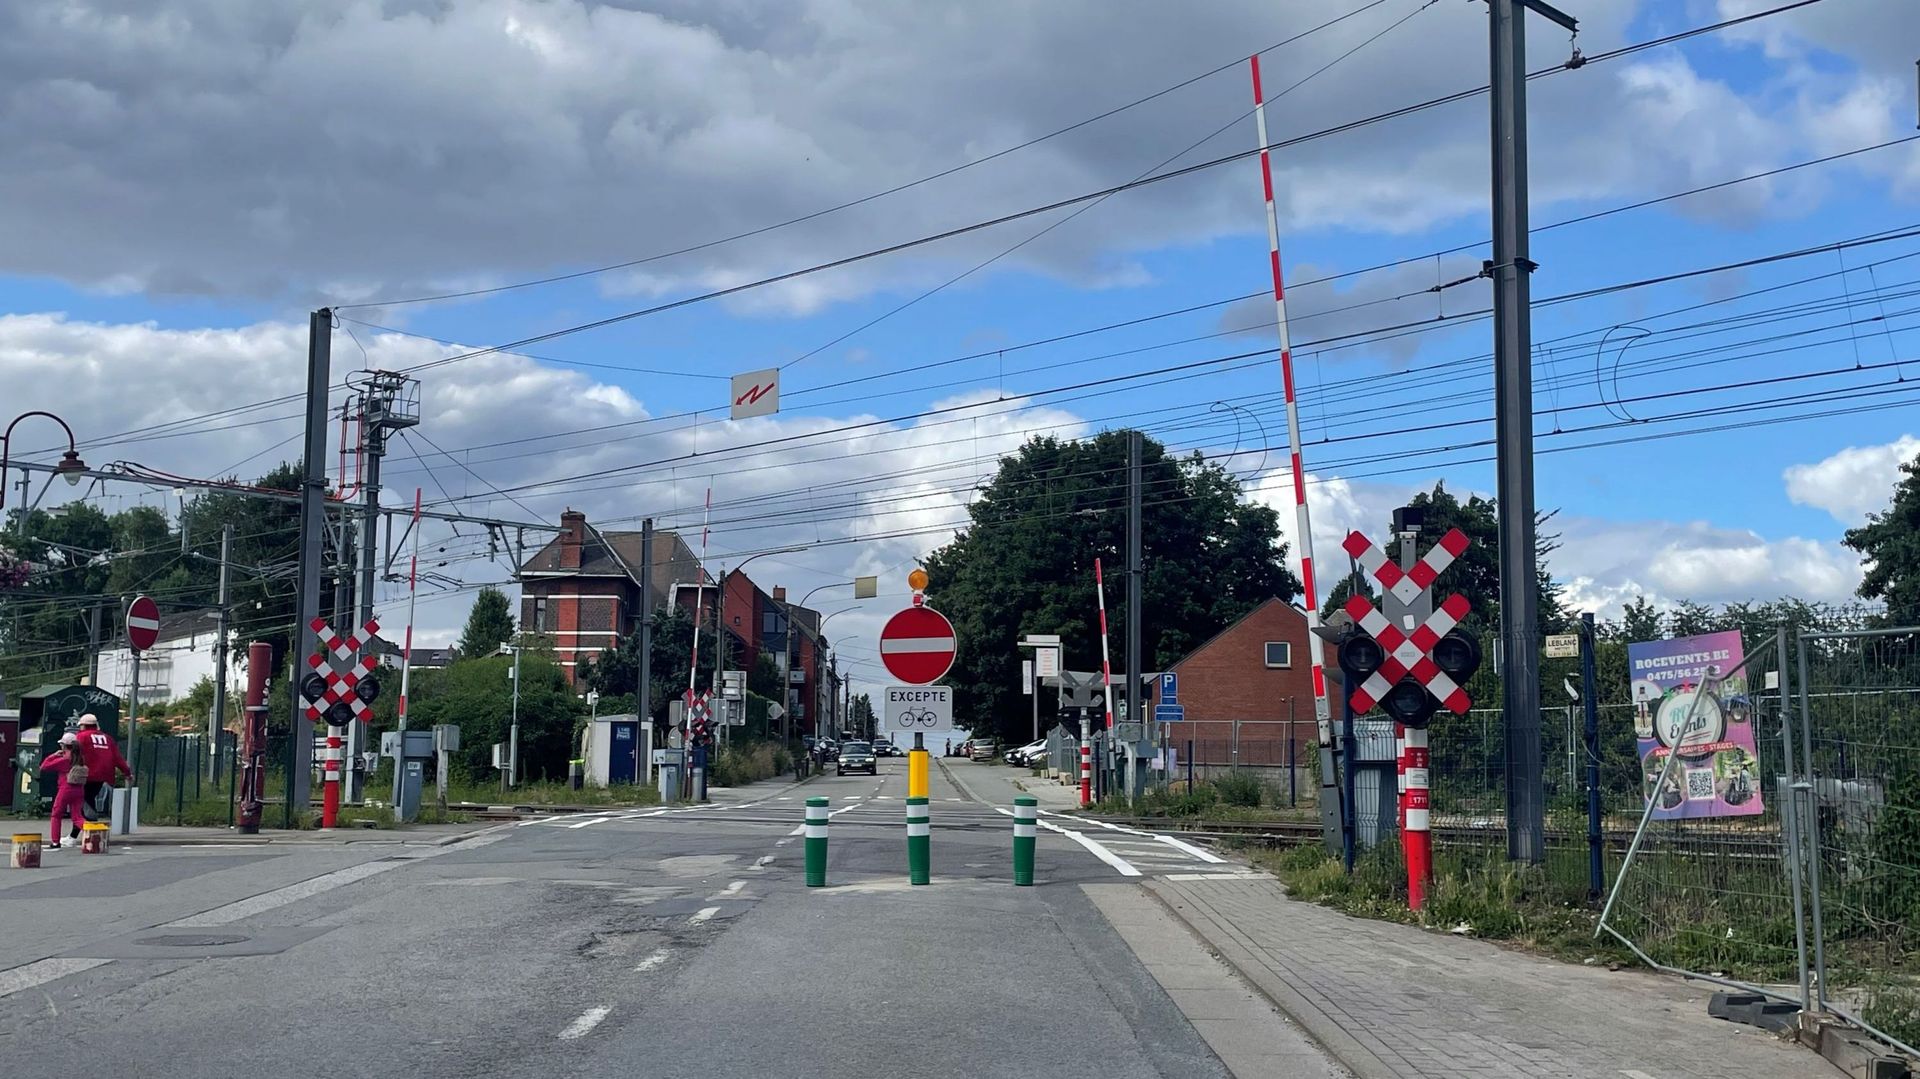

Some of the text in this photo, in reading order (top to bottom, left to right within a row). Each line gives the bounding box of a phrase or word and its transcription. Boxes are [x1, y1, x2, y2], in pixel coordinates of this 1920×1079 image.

[1548, 638, 1577, 647] LEBLANC
[1635, 650, 1730, 670] ROCEVENTS.BE
[1646, 665, 1721, 681] 0475/56.253
[1164, 675, 1174, 688] P
[890, 691, 947, 702] EXCEPTE
